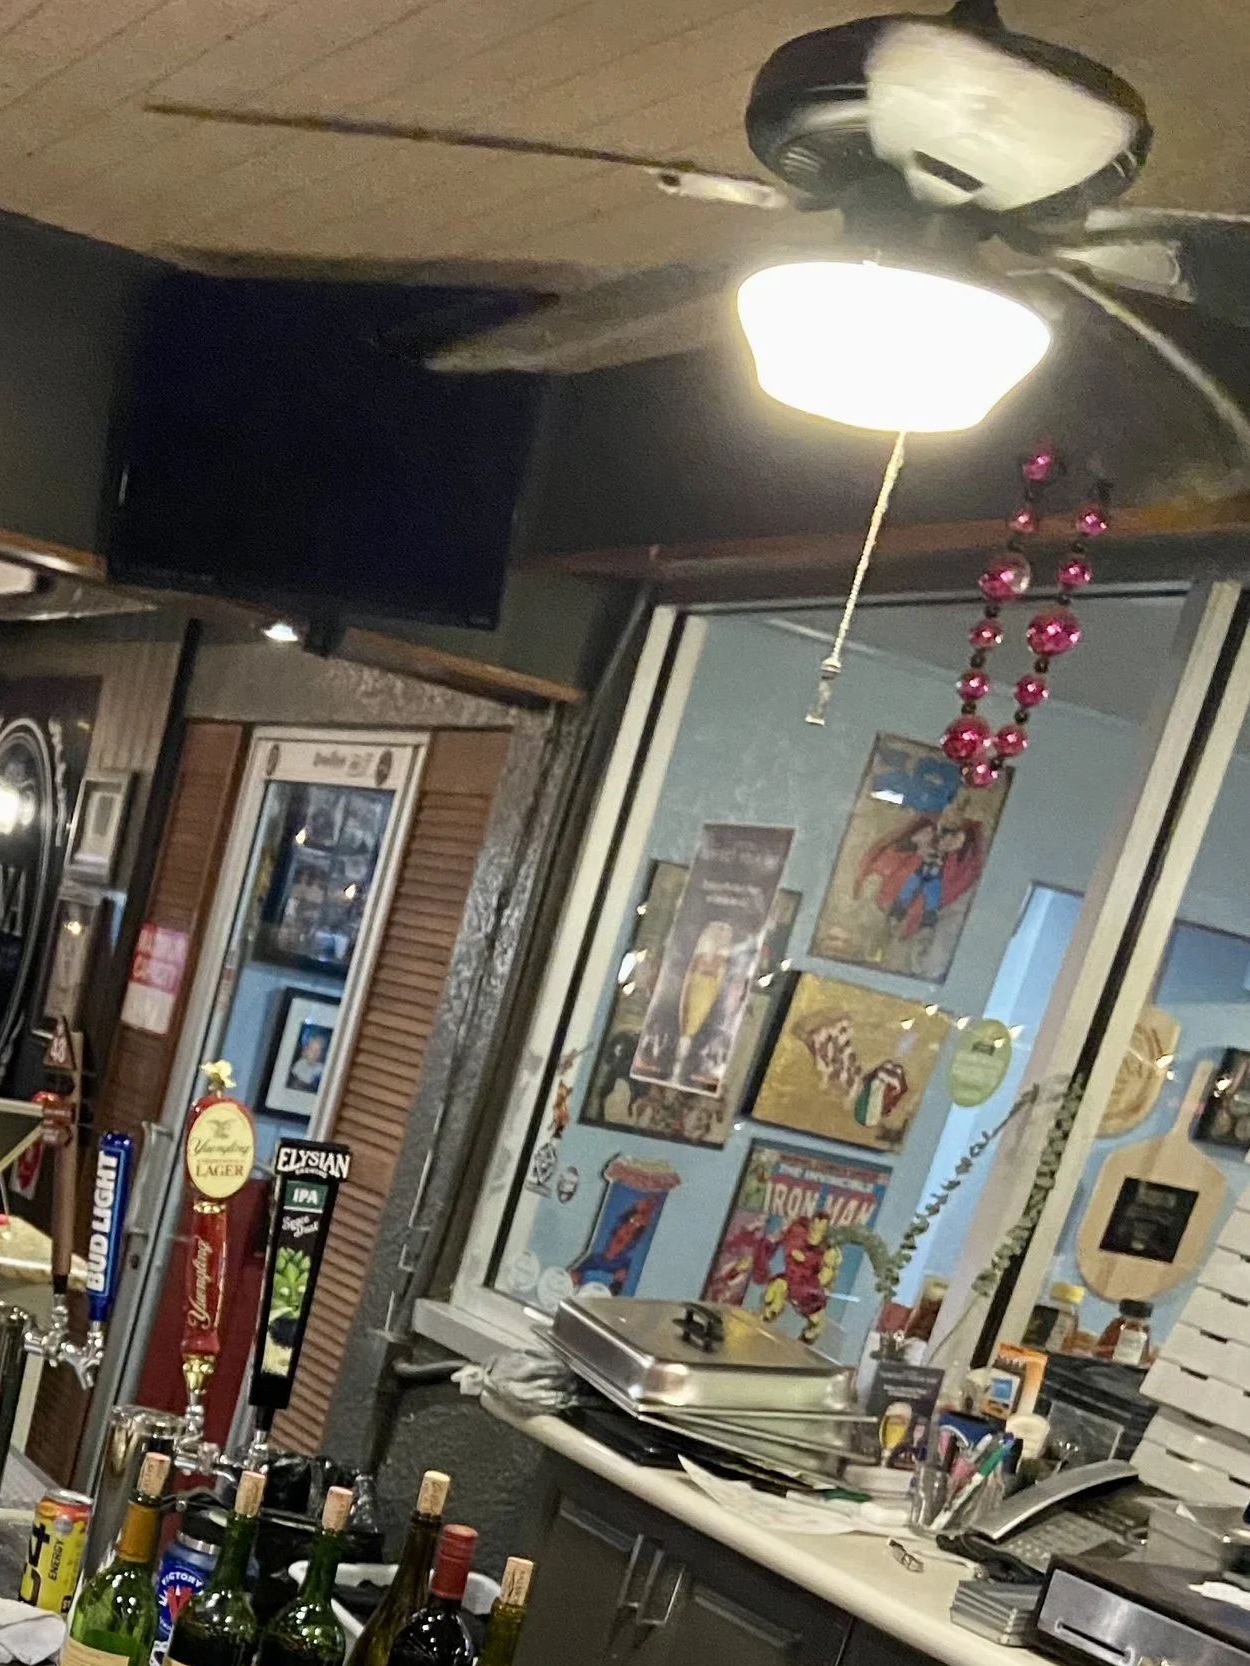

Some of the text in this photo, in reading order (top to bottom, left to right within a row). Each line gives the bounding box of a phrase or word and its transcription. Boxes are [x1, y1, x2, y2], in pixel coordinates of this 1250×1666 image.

[196, 1163, 244, 1177] LAGER
[277, 1147, 351, 1179] ELYSIAN
[293, 1187, 319, 1206] IPA
[763, 1180, 877, 1227] IRON MAN
[86, 1150, 118, 1292] BUD LIGHT
[48, 1540, 64, 1581] ENERGY
[161, 1571, 204, 1588] VICTORY
